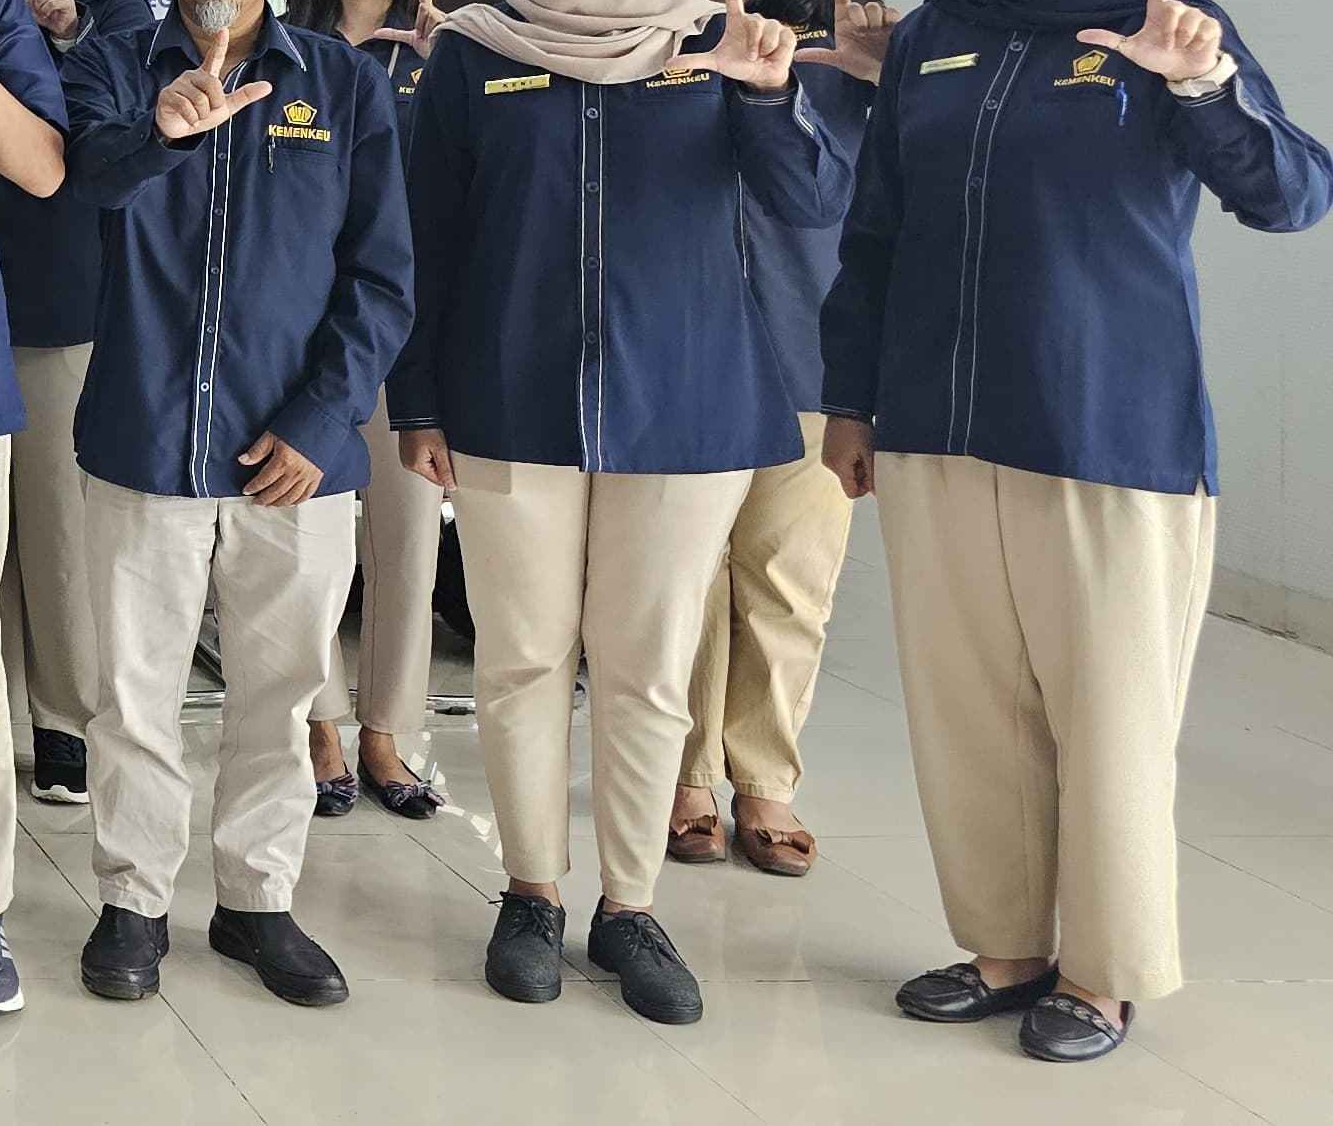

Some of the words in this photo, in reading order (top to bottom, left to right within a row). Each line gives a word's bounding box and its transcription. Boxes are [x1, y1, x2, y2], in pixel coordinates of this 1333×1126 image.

[646, 72, 711, 88] KEMENKEU
[1053, 74, 1115, 87] KEMENKEU
[268, 124, 331, 142] KEMENKEU
